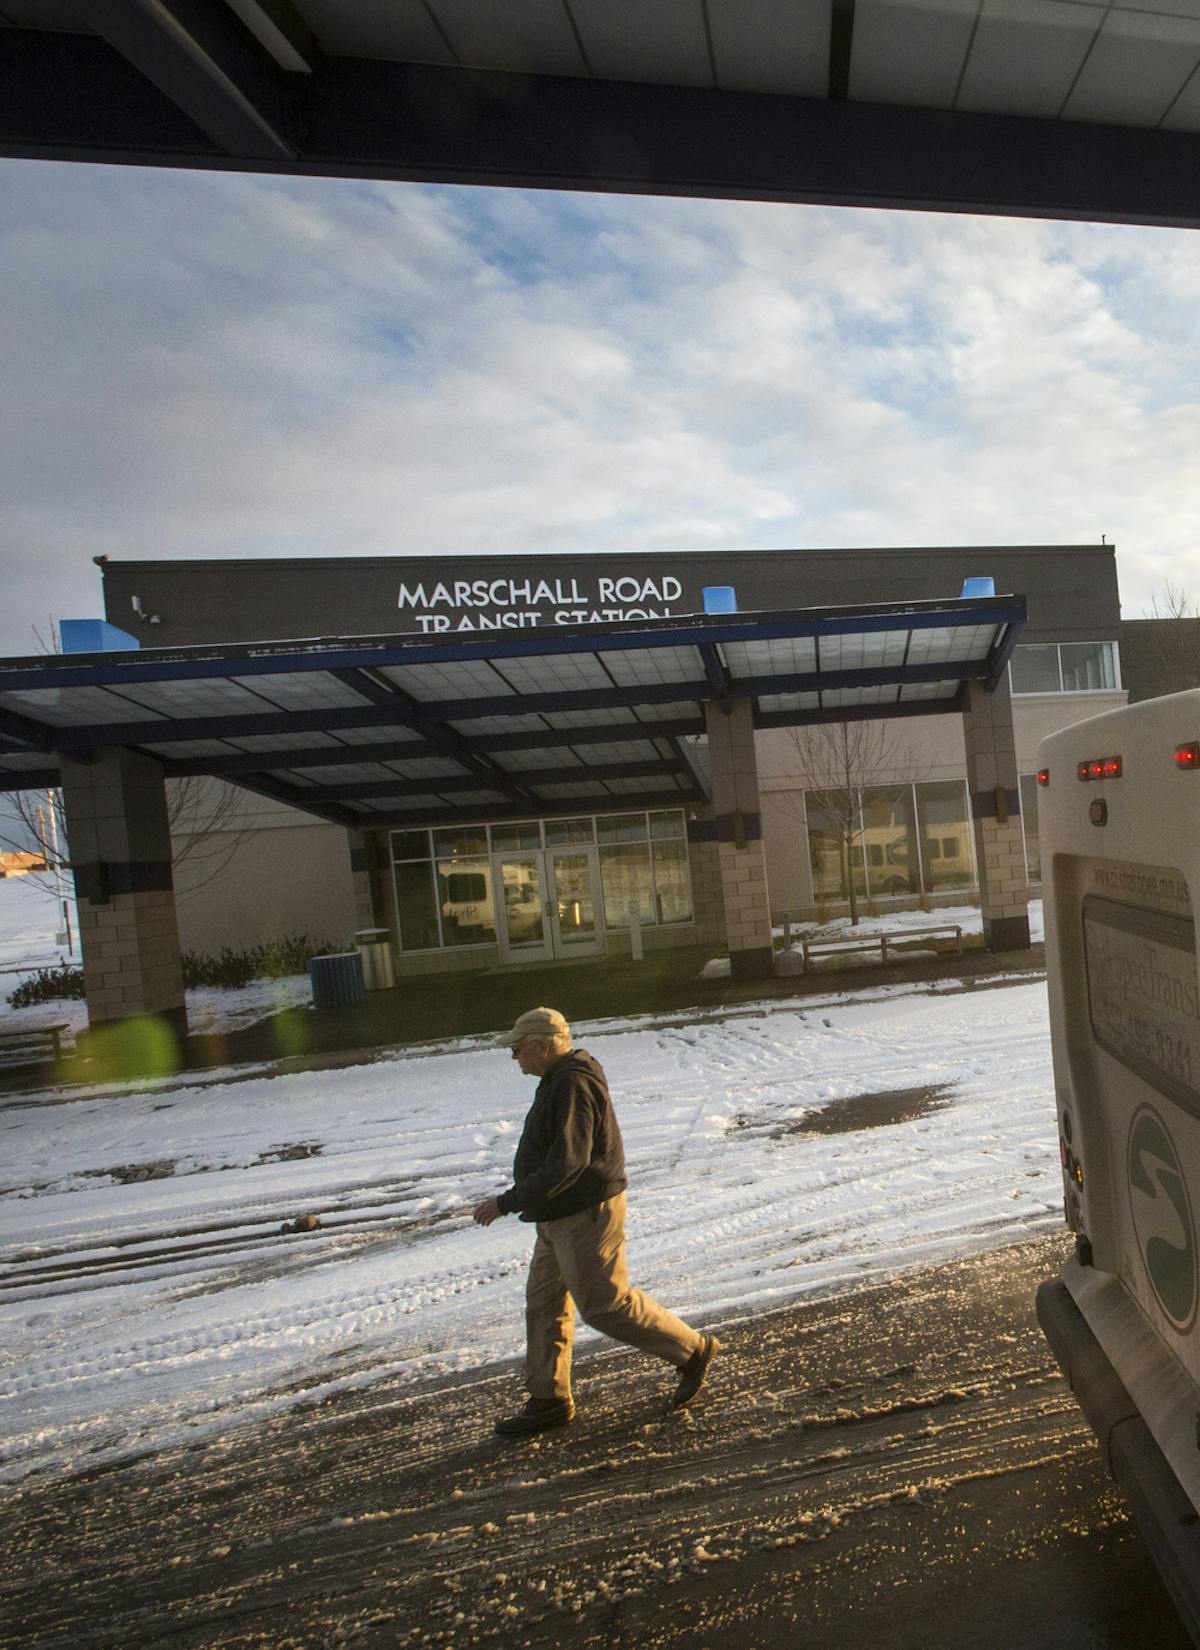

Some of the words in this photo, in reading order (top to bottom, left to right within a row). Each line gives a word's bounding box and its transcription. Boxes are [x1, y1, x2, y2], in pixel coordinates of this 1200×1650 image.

[398, 578, 589, 609] MARSCHALL
[598, 576, 683, 604] ROAD
[414, 611, 542, 634] TRANSIT
